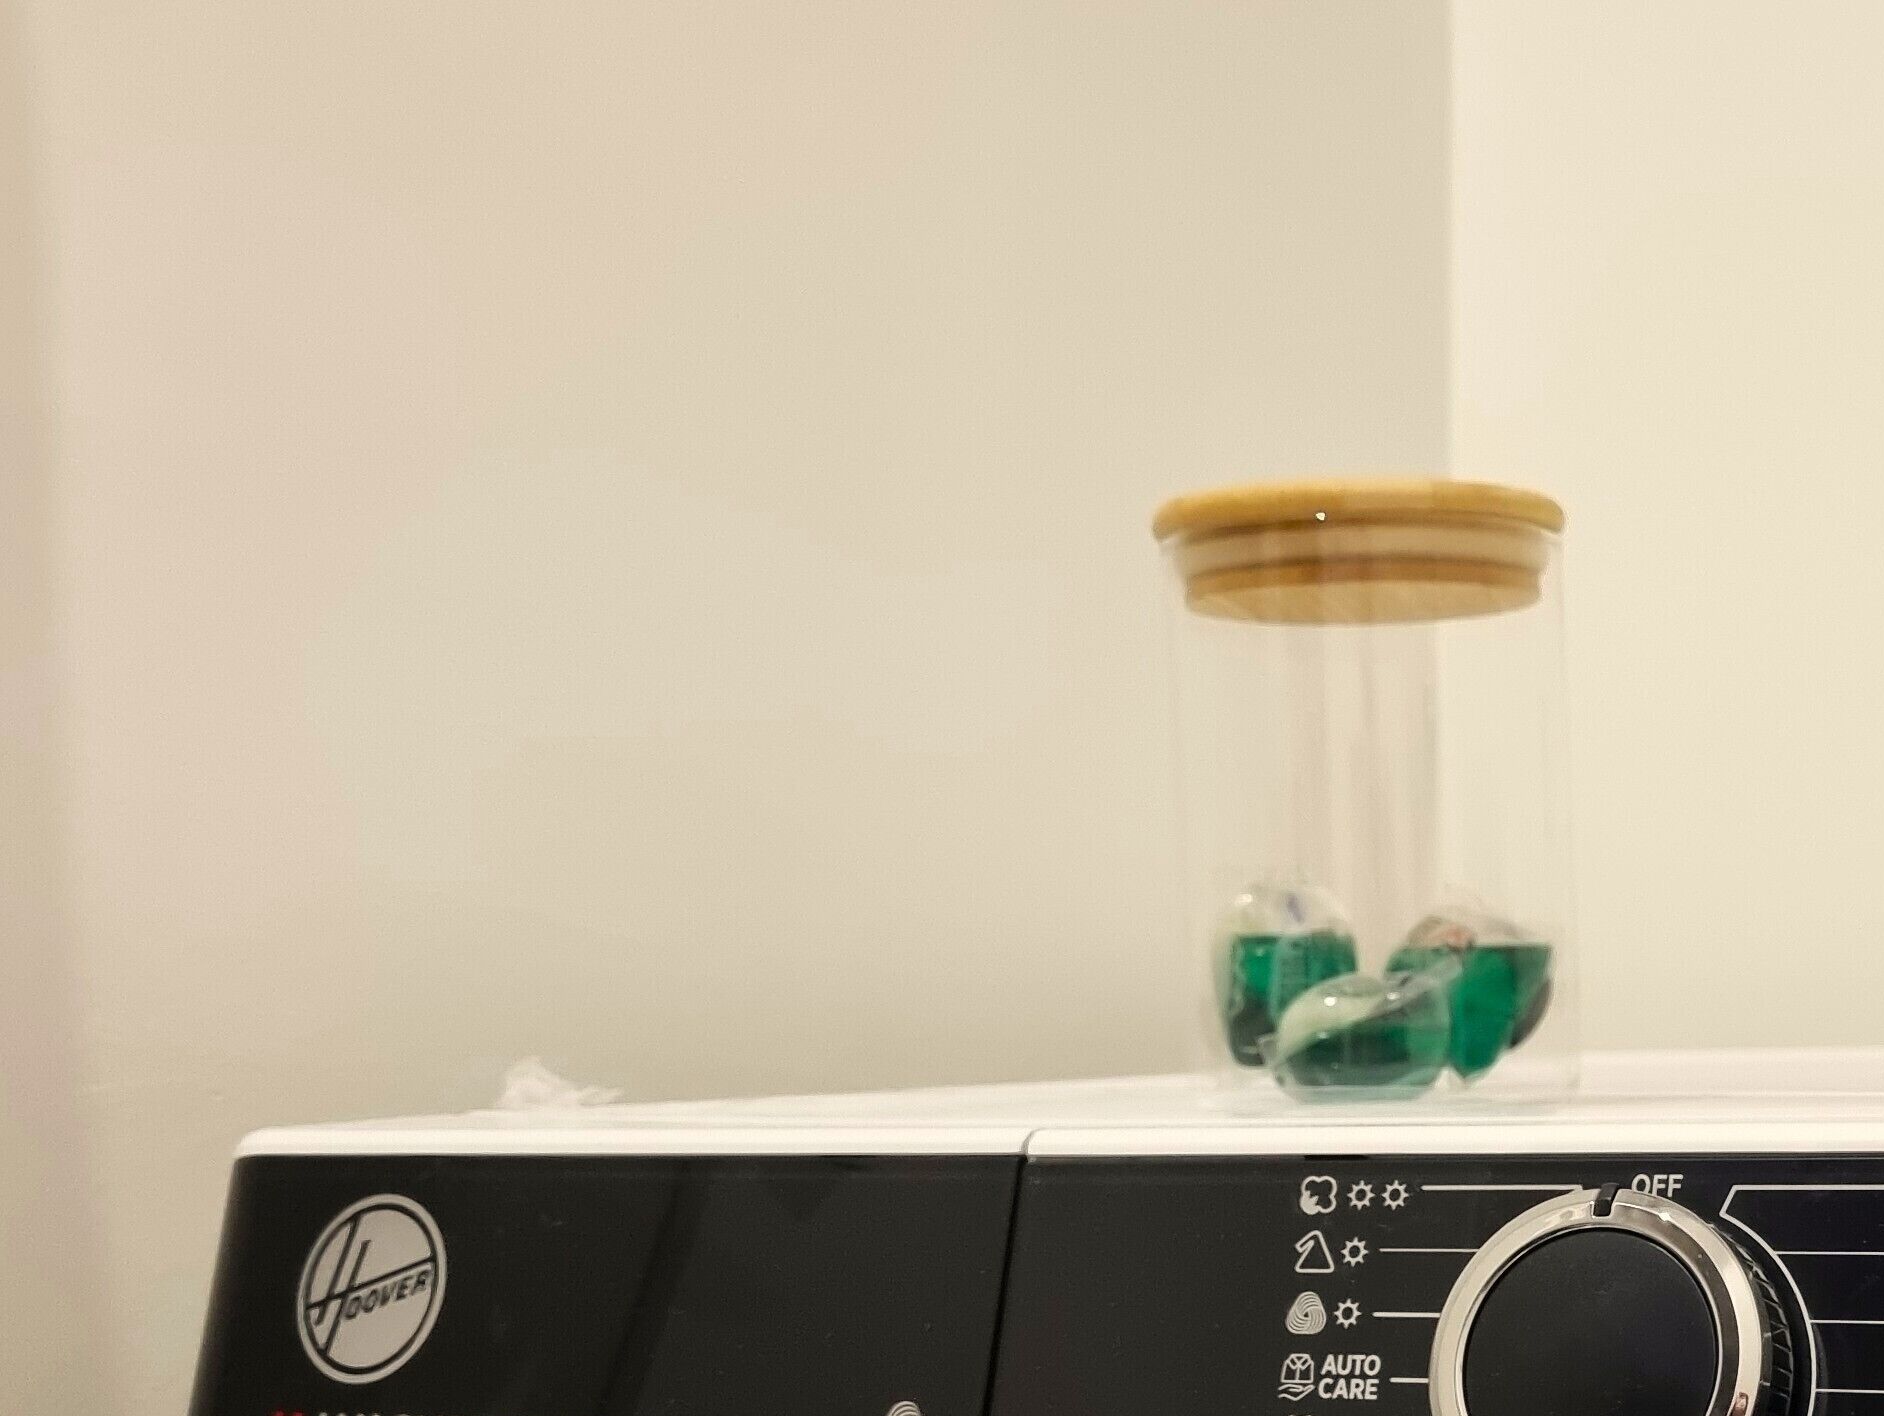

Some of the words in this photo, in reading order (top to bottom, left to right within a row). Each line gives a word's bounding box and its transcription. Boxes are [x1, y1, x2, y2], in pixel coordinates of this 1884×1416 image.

[1631, 1173, 1684, 1198] OFF
[1320, 1354, 1382, 1376] AUTO
[1317, 1377, 1380, 1400] CARE
